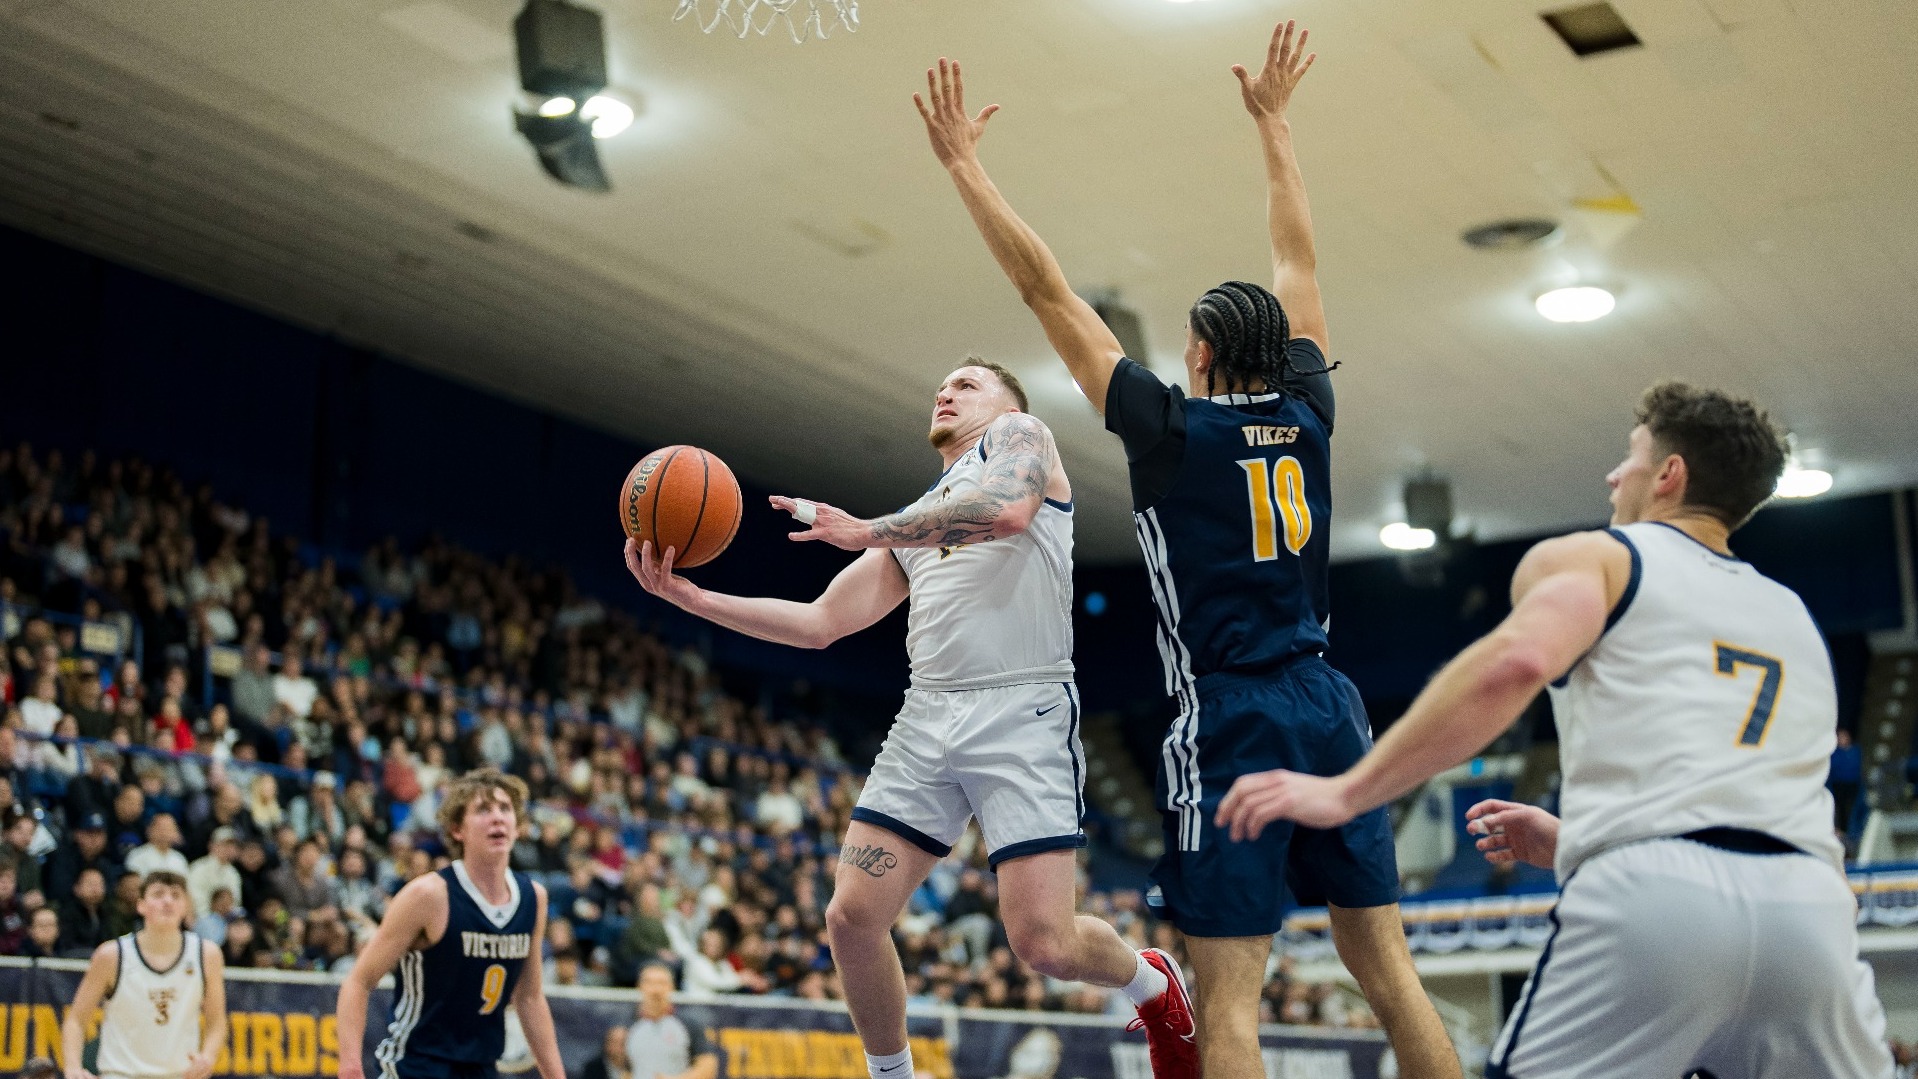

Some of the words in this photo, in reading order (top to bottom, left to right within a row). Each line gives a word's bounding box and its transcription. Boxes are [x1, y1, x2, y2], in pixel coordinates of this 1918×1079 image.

[1242, 425, 1300, 447] VIKES
[1235, 456, 1312, 562] 10
[1713, 638, 1785, 748] 7
[479, 963, 508, 1015] 9
